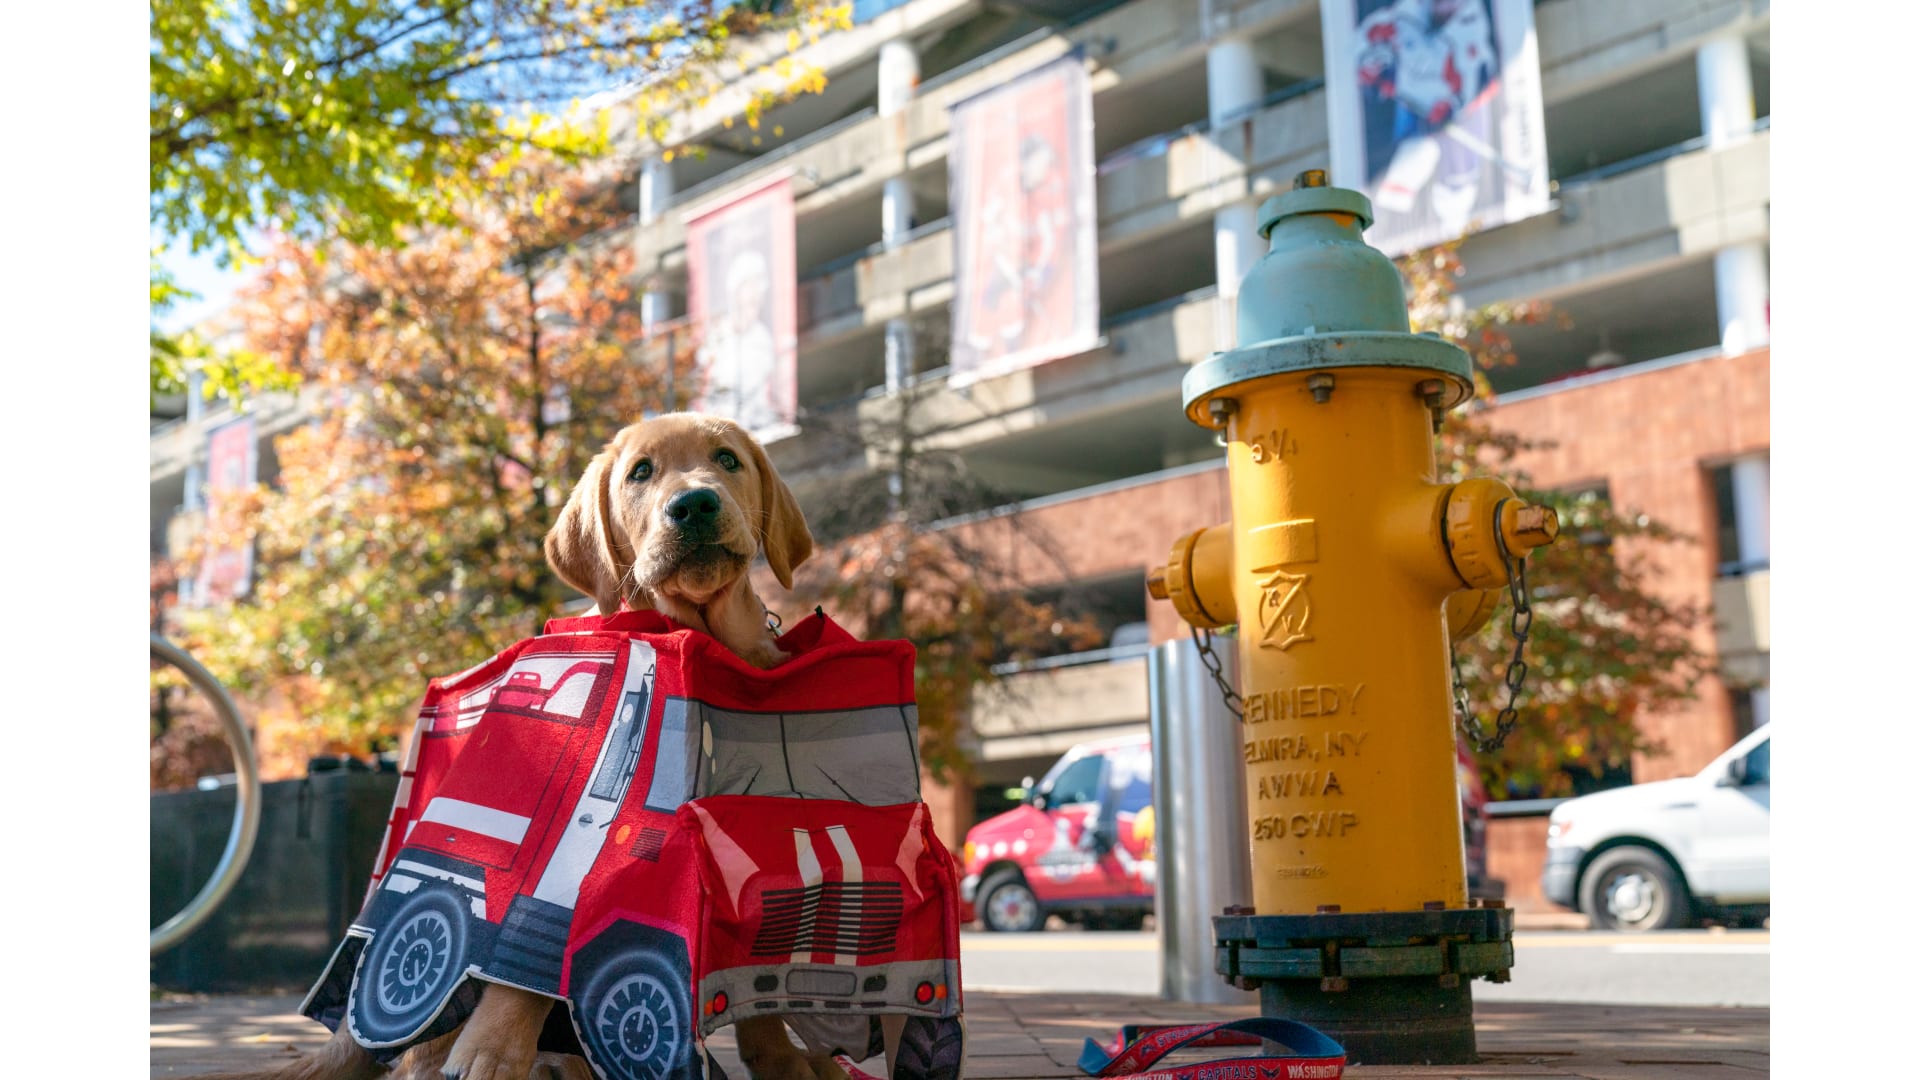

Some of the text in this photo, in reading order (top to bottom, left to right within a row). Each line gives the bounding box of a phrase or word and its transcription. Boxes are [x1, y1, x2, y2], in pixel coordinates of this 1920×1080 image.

[1243, 683, 1367, 724] KENNEDY
[1325, 730, 1368, 758] NY
[1258, 769, 1345, 800] AWWA
[1254, 810, 1361, 841] 250 CWP
[1198, 1065, 1257, 1080] CAPITALS
